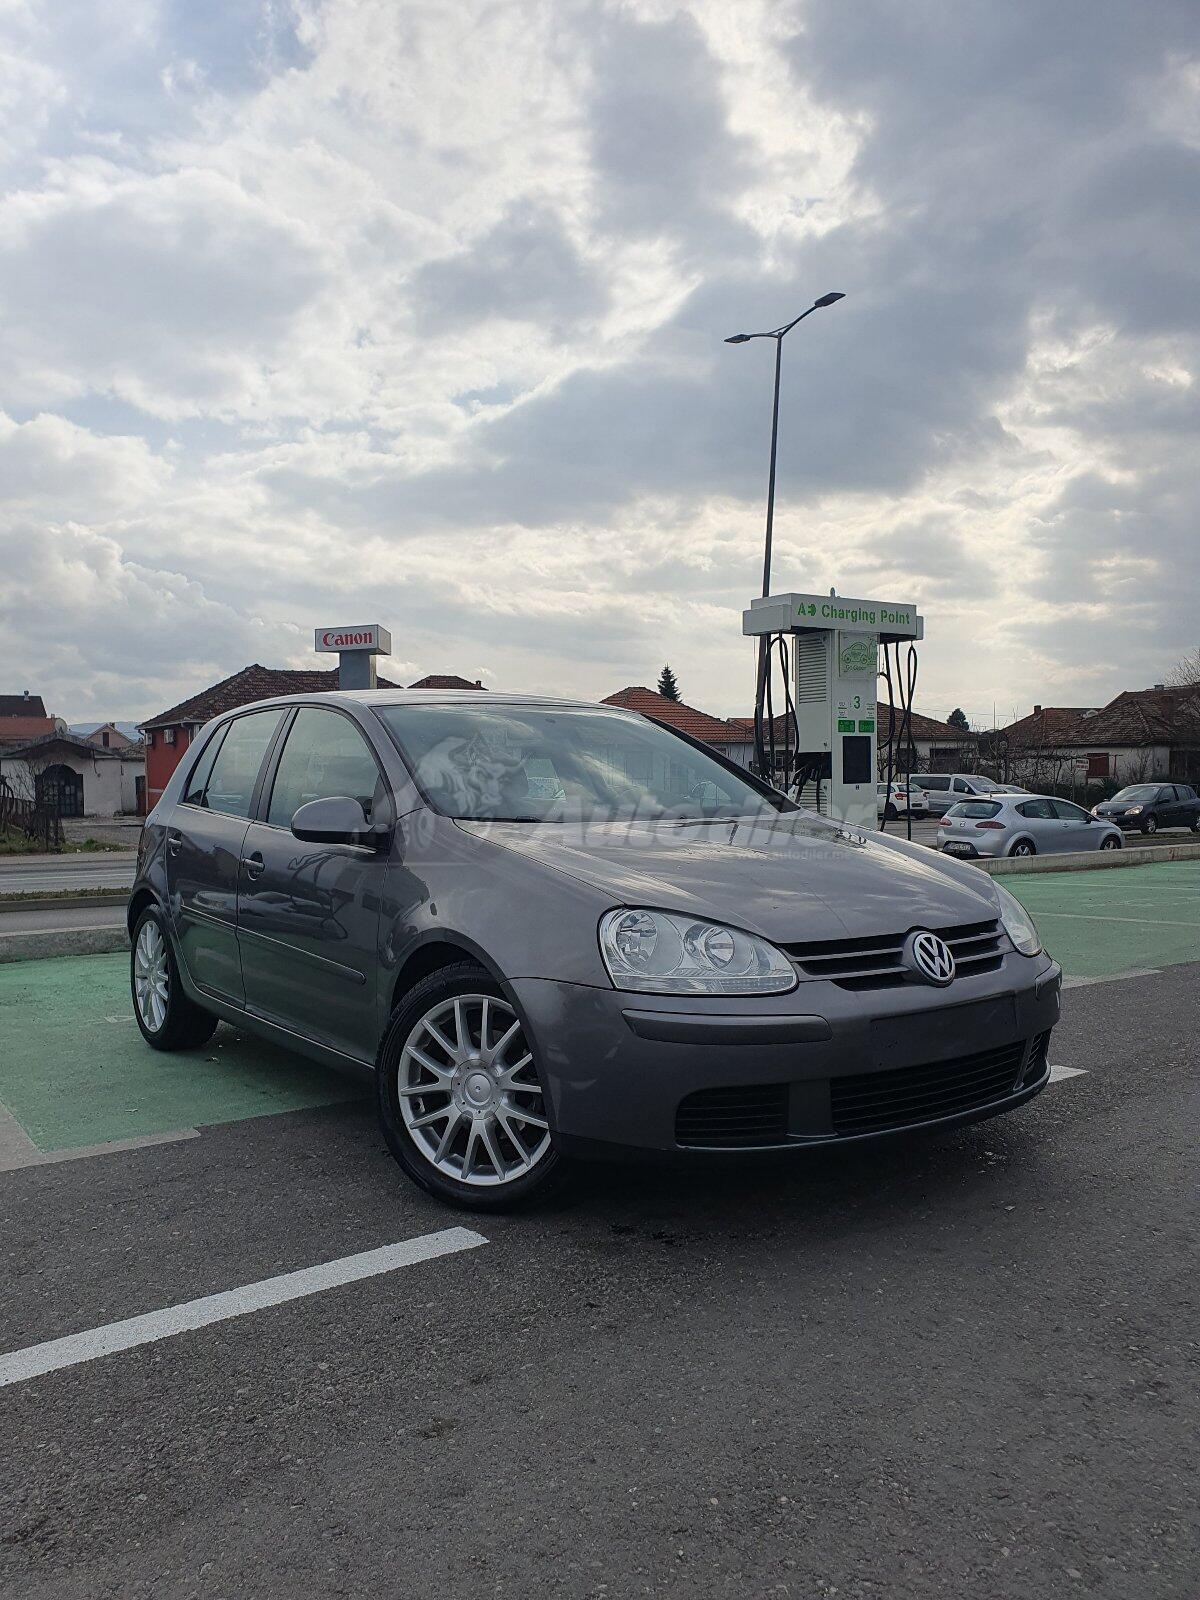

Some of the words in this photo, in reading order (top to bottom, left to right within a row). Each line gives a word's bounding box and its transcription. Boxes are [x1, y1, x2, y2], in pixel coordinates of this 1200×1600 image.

[821, 604, 876, 624] Charging
[881, 609, 910, 625] Point
[322, 632, 373, 647] Canon
[853, 695, 861, 710] 3
[916, 934, 953, 980] VW
